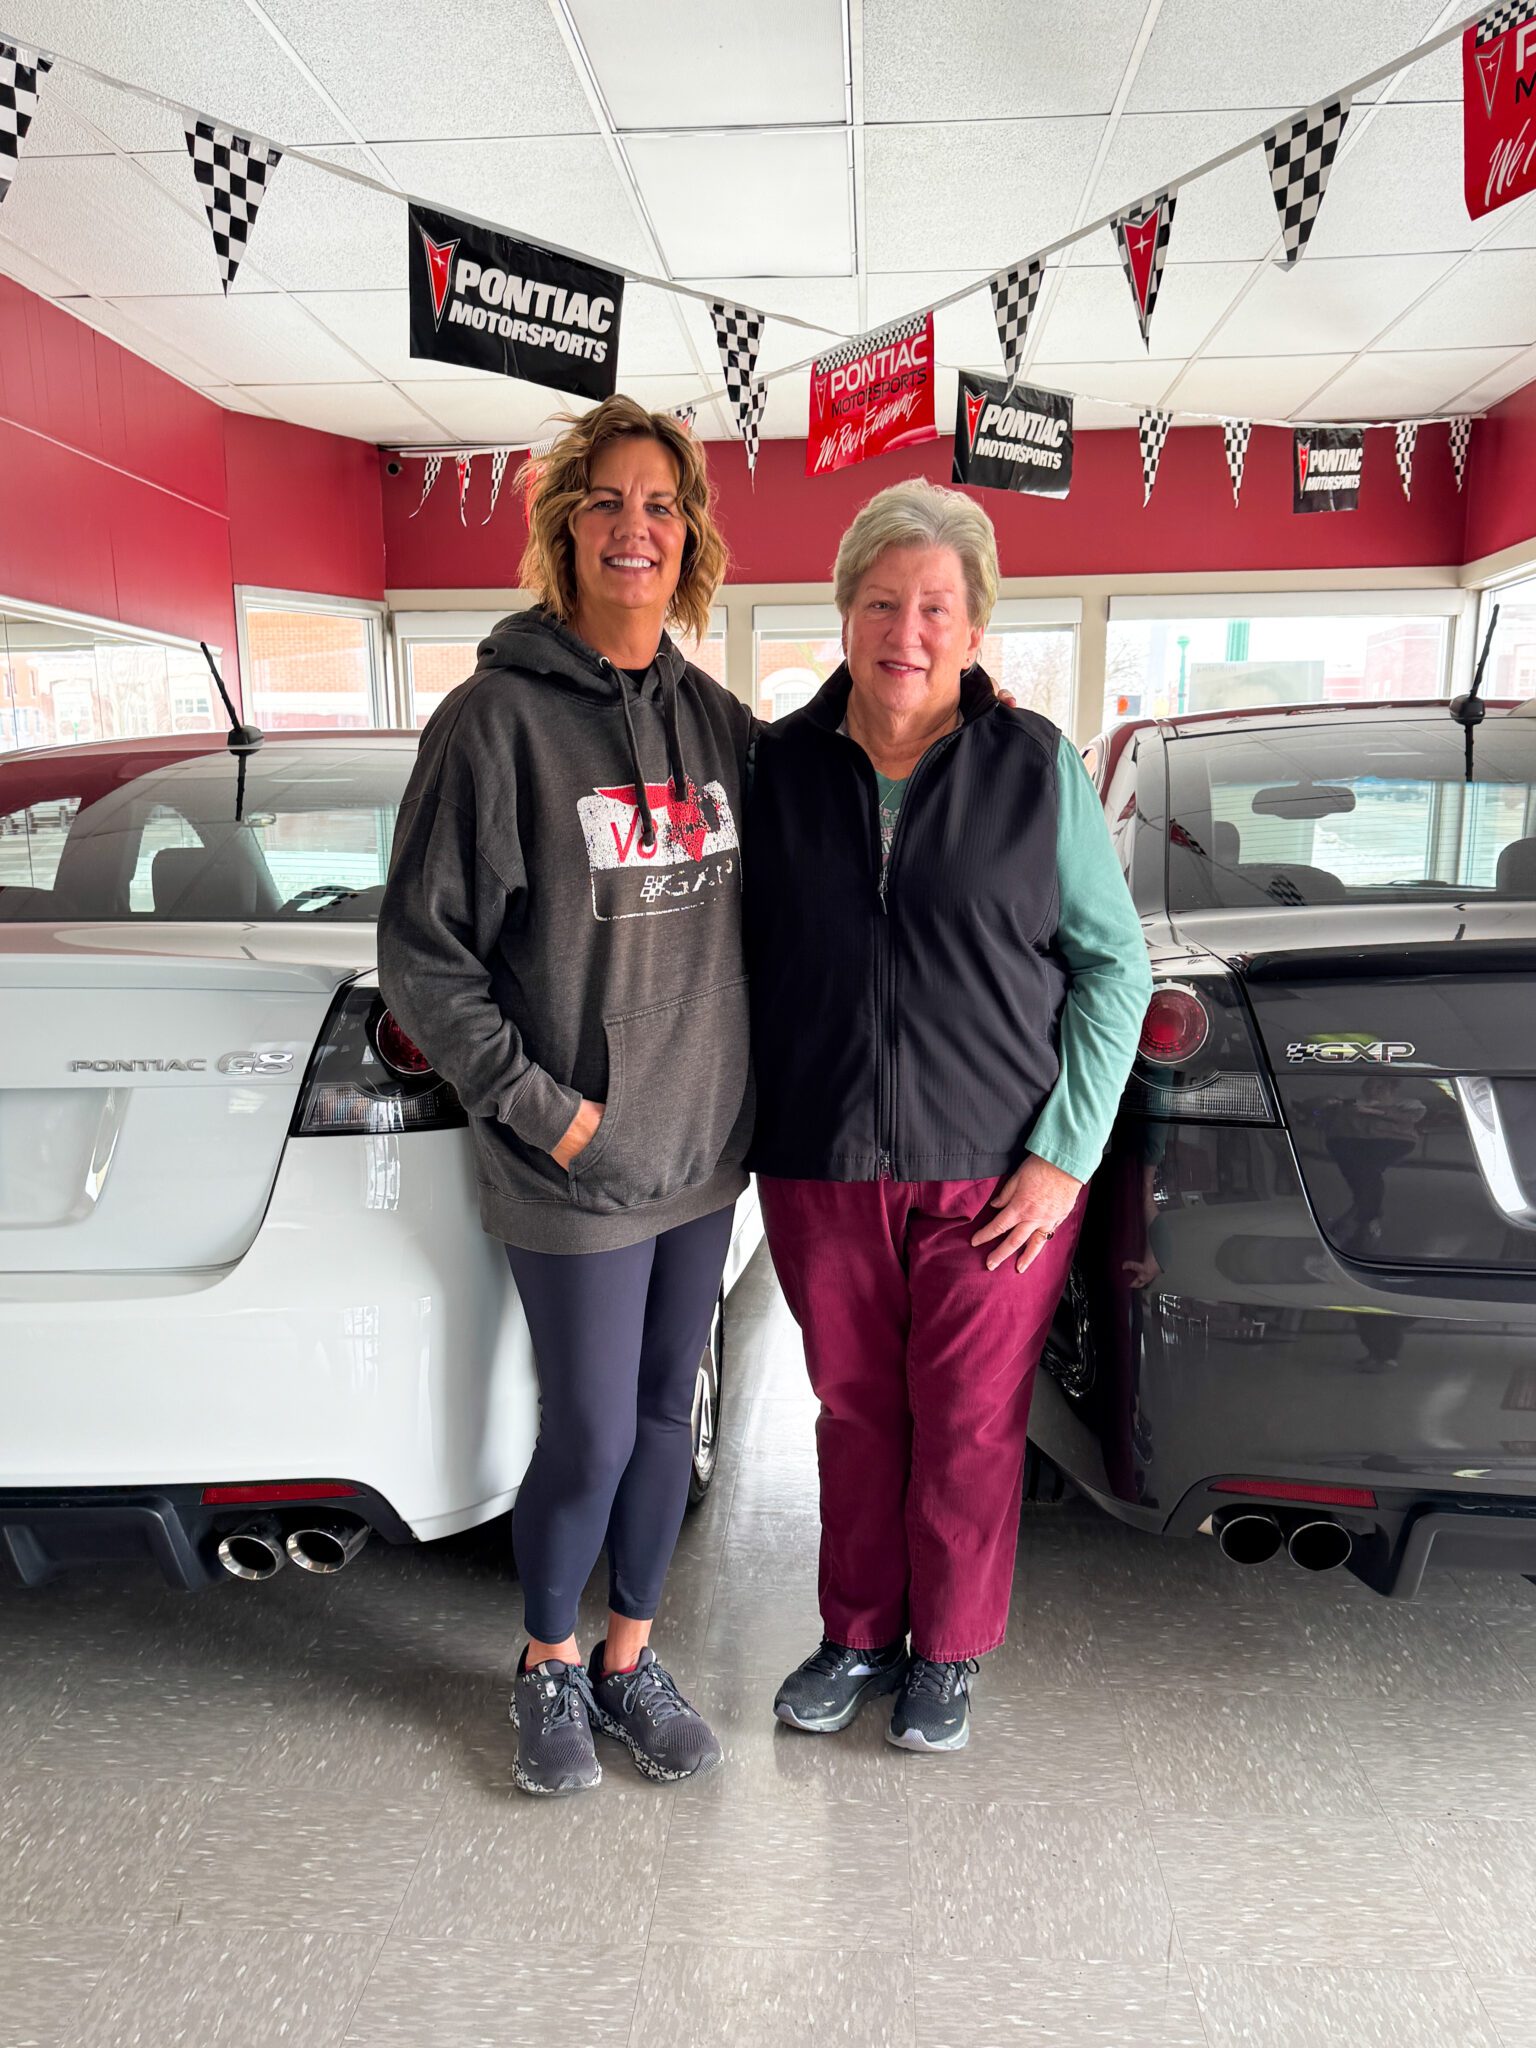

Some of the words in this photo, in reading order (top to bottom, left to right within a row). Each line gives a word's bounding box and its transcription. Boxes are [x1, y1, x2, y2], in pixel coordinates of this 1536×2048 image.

[455, 258, 615, 334] PONTIAC
[448, 300, 608, 363] MOTORSPORTS
[831, 334, 927, 399] PONTIAC
[831, 367, 927, 419] MOTORSPORTS
[980, 404, 1068, 448] PONTIAC
[975, 438, 1062, 470] MOTORSPORTS
[1309, 448, 1363, 473] PONTIAC
[1304, 474, 1360, 492] MOTORSPORTS
[71, 1058, 208, 1072] PONTIAC
[216, 1050, 294, 1076] G8
[1313, 1041, 1416, 1064] GXP
